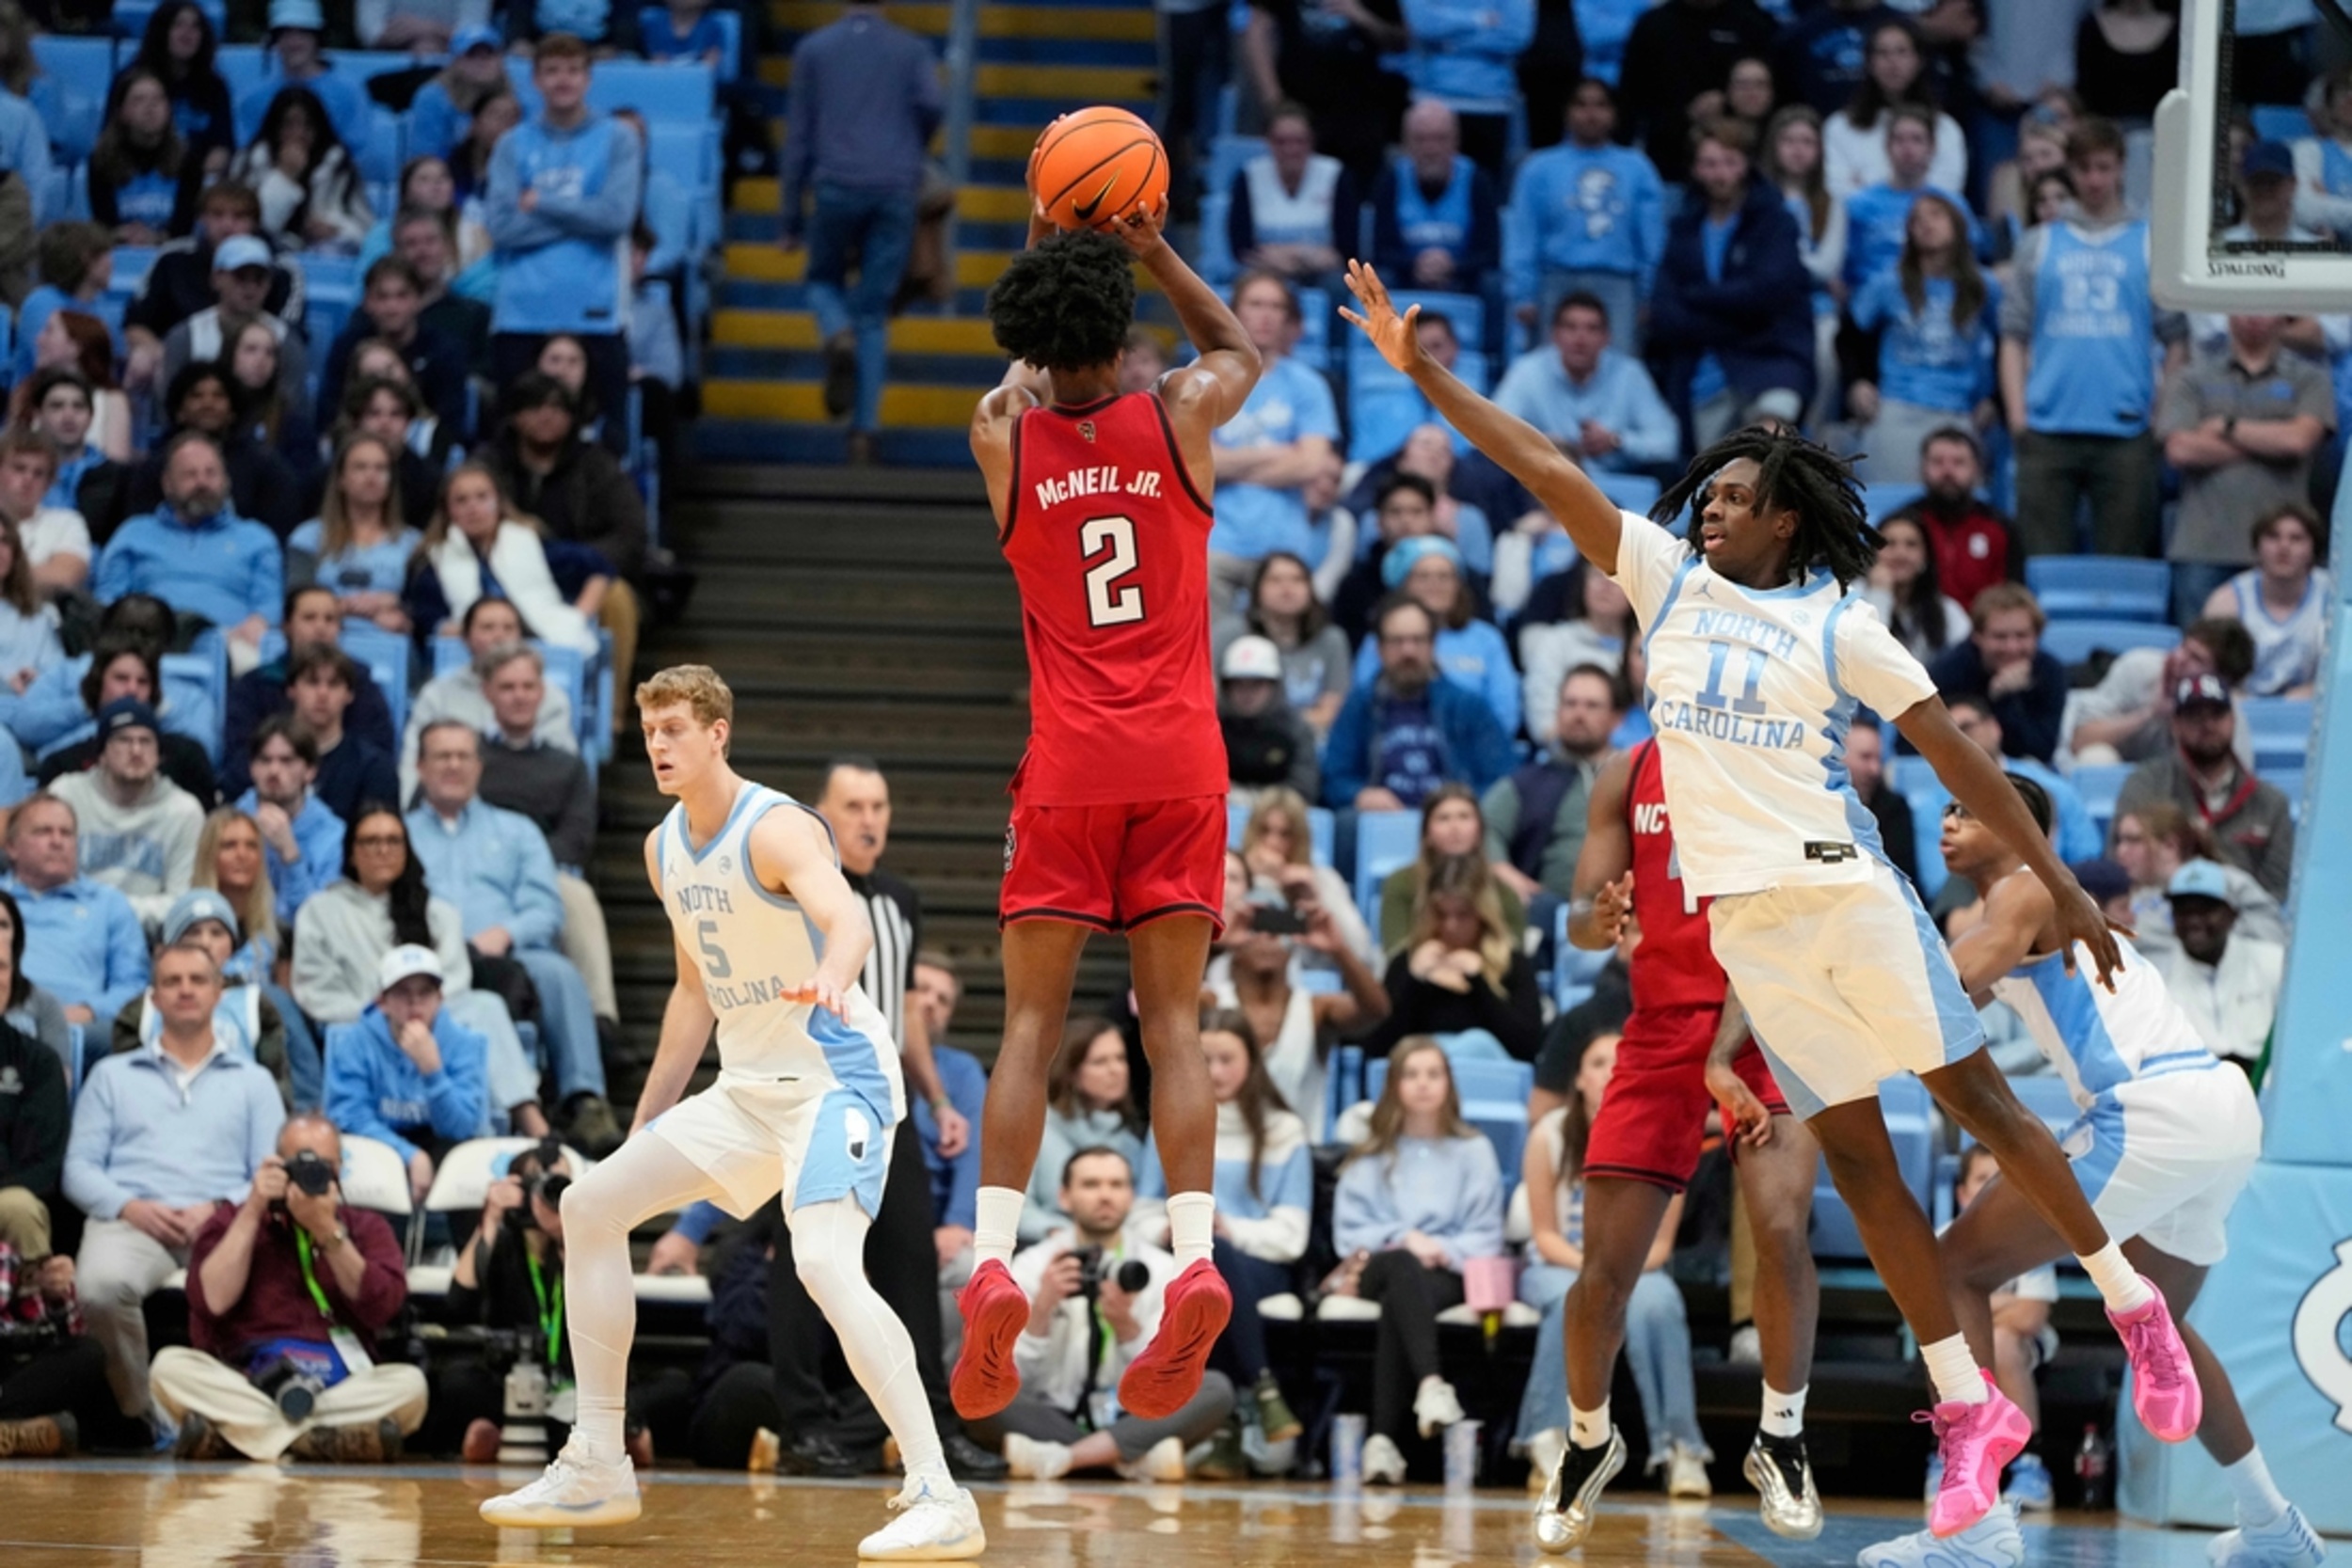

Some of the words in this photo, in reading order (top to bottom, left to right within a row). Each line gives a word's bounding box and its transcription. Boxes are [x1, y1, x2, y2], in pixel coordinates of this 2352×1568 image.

[2207, 262, 2284, 278] SPALDING
[1035, 466, 1120, 511] McNEIL
[1125, 470, 1162, 499] JR.
[1078, 514, 1146, 629] 2
[1692, 610, 1799, 661] NORTH
[1695, 640, 1770, 715] 11
[1661, 701, 1804, 749] CAROLINA
[1634, 803, 1666, 834] NC
[676, 885, 735, 914] NOTH
[698, 919, 732, 978] 5
